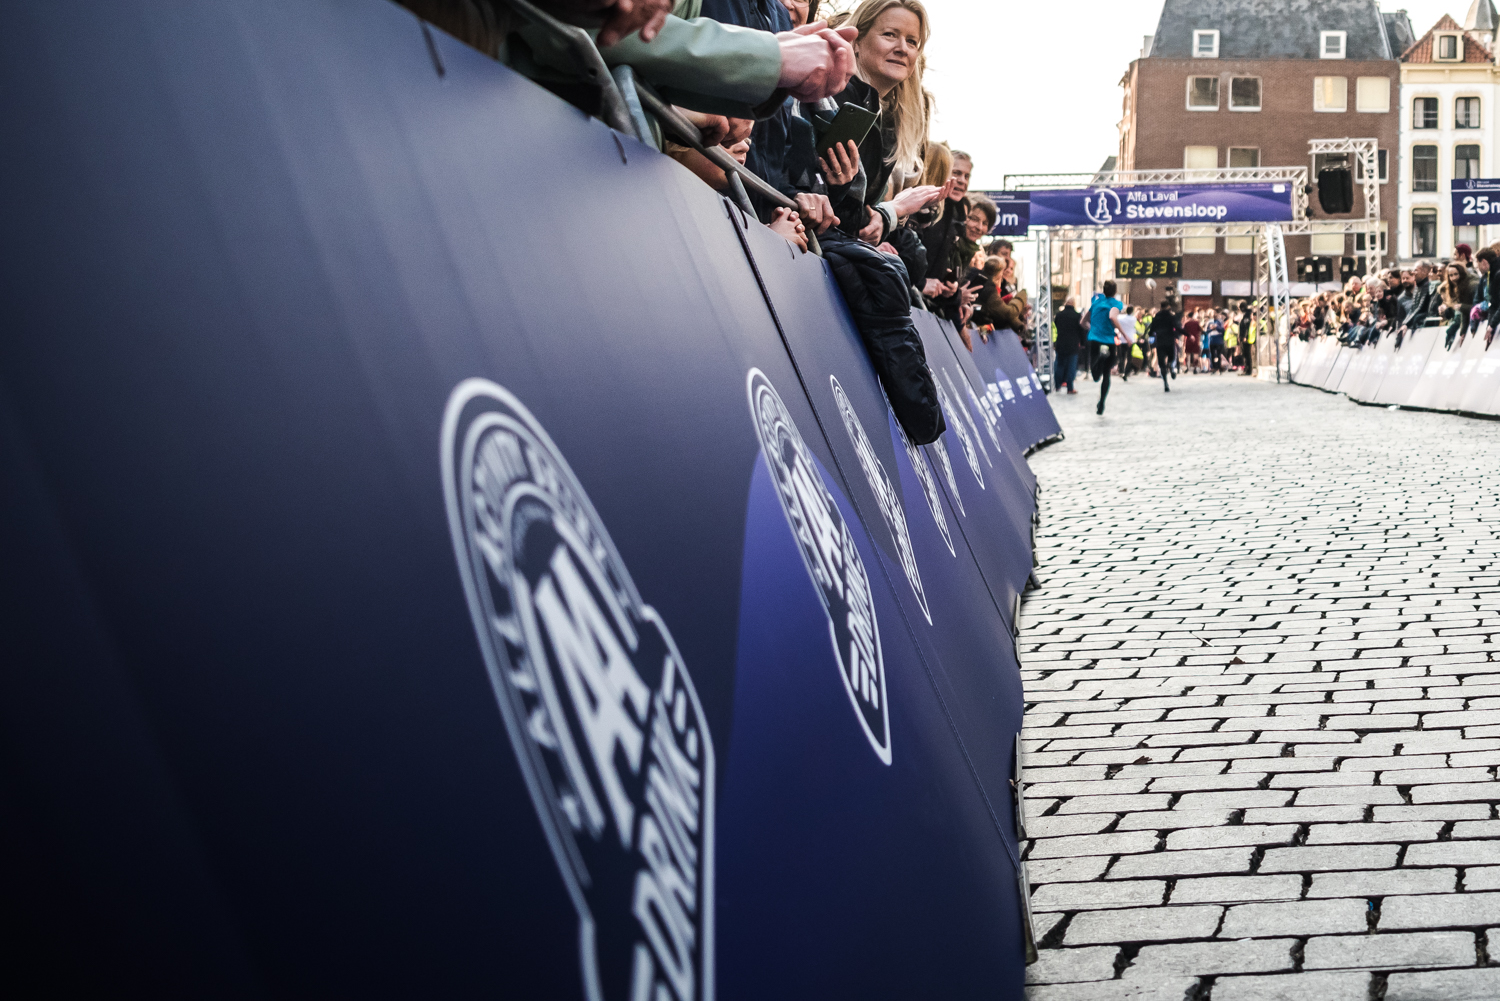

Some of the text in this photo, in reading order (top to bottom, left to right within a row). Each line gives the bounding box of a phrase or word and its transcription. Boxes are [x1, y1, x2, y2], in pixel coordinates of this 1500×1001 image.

[1126, 191, 1179, 202] Alfa Laval
[1126, 204, 1227, 219] Stevensloop
[1120, 261, 1179, 275] 0:23:37
[535, 545, 651, 849] AA
